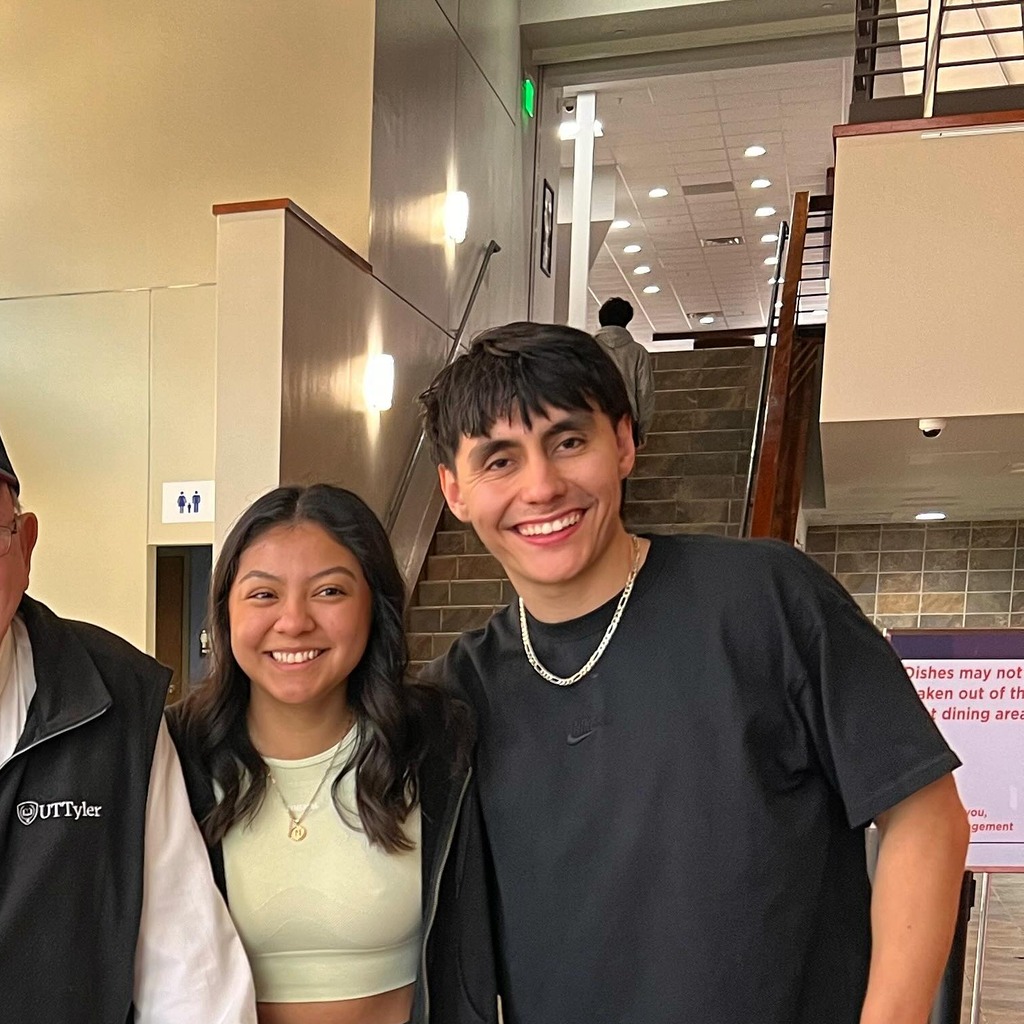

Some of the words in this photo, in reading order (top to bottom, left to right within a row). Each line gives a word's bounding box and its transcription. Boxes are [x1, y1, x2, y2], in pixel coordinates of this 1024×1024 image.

[905, 666, 955, 680] Dishes
[959, 668, 991, 682] may
[996, 667, 1023, 680] not
[917, 686, 953, 700] aken
[958, 687, 984, 700] out
[989, 686, 1006, 700] of
[1010, 686, 1024, 700] th
[942, 708, 990, 723] dining
